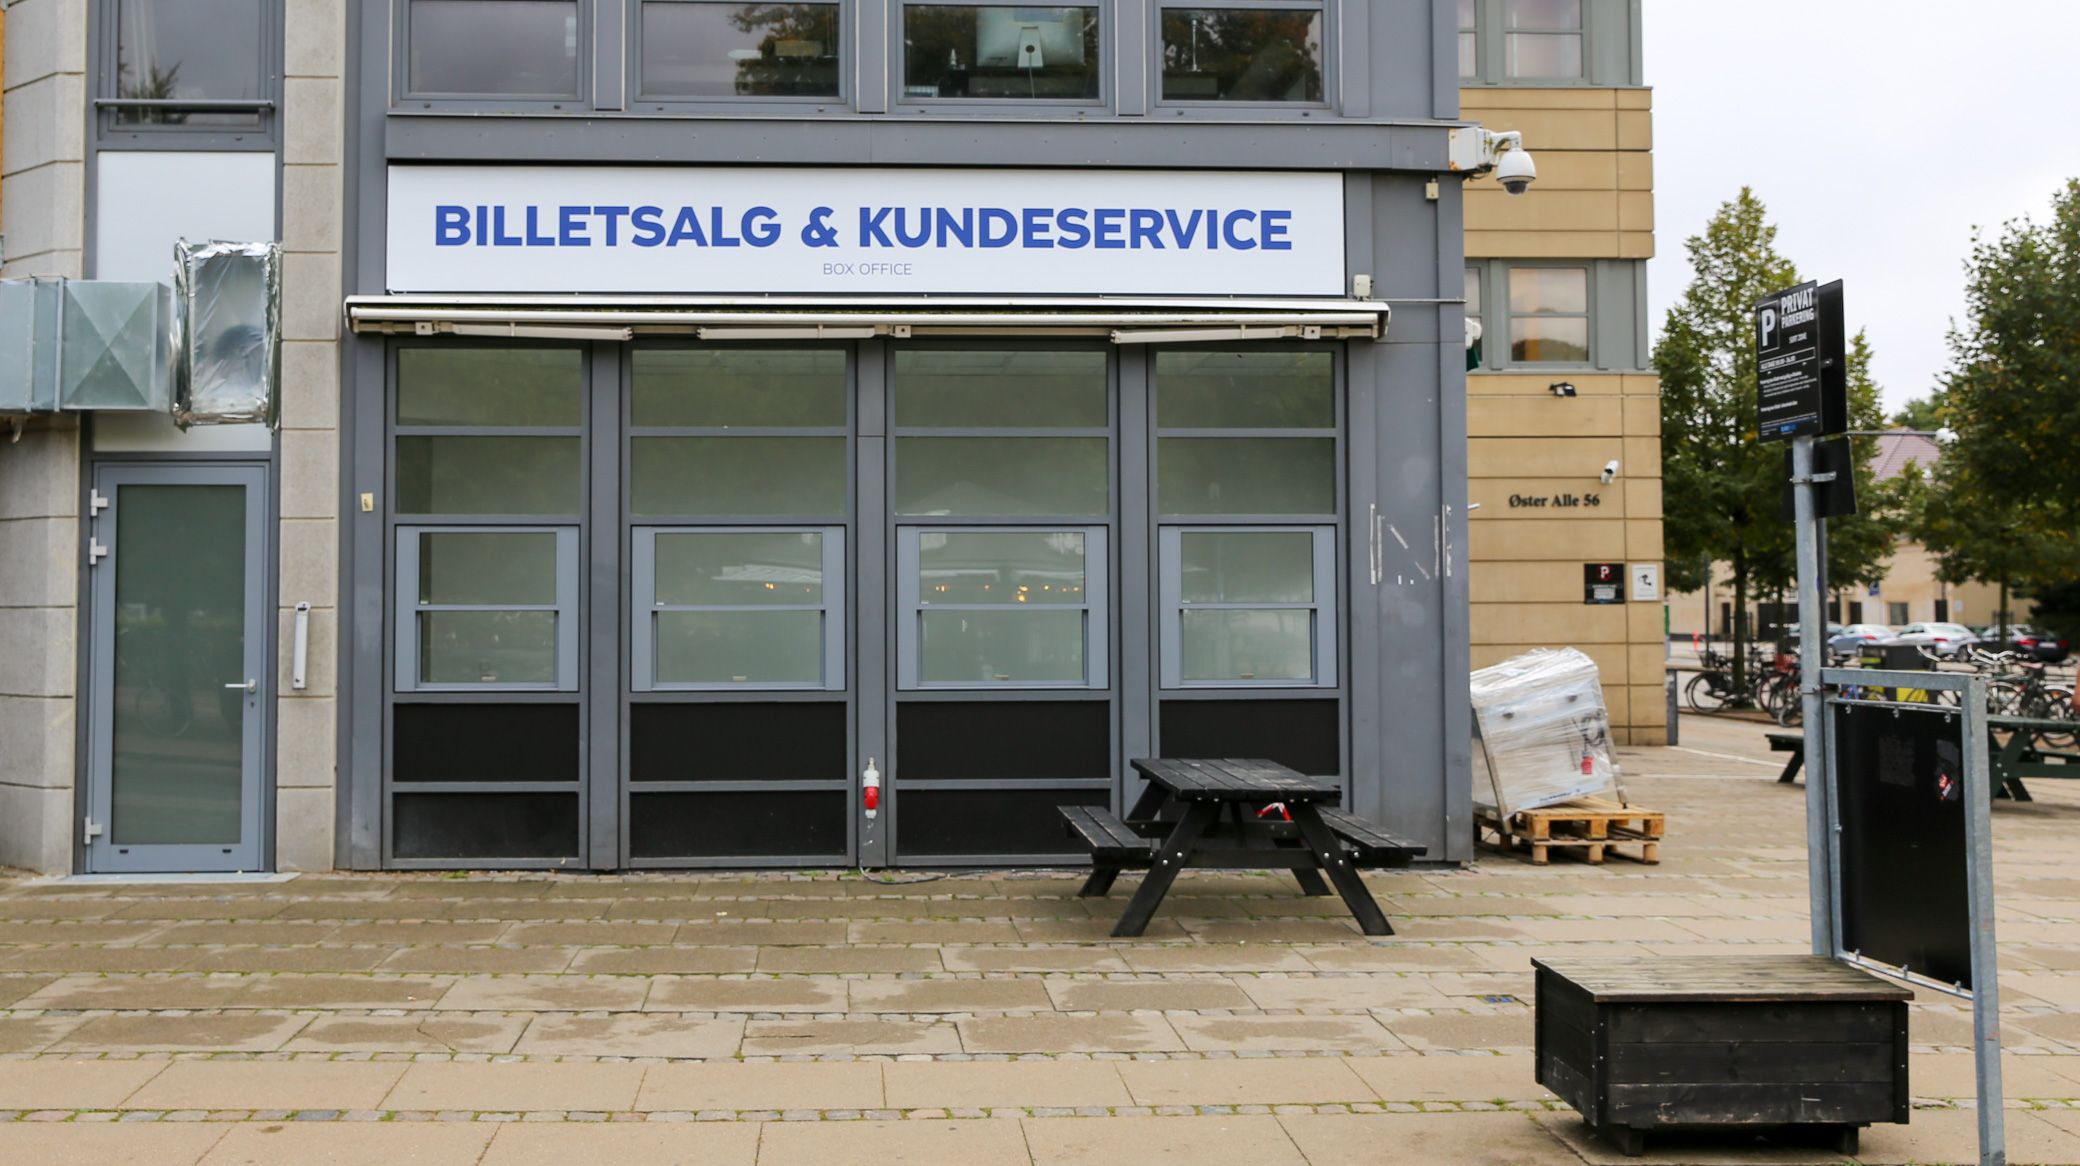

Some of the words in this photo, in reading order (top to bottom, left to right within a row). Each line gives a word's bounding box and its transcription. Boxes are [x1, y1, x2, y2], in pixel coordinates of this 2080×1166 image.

[436, 205, 781, 248] BILLETSALG
[801, 207, 838, 248] &
[860, 207, 1292, 251] KUNDESERVICE
[823, 262, 854, 275] BOX
[859, 263, 912, 276] OFFICE
[1781, 288, 1814, 315] PRIVAT
[1761, 308, 1776, 347] P
[1781, 307, 1815, 329] PARKERING
[1509, 494, 1548, 508] Øster
[1551, 493, 1580, 507] Alle
[1583, 493, 1601, 507] 56
